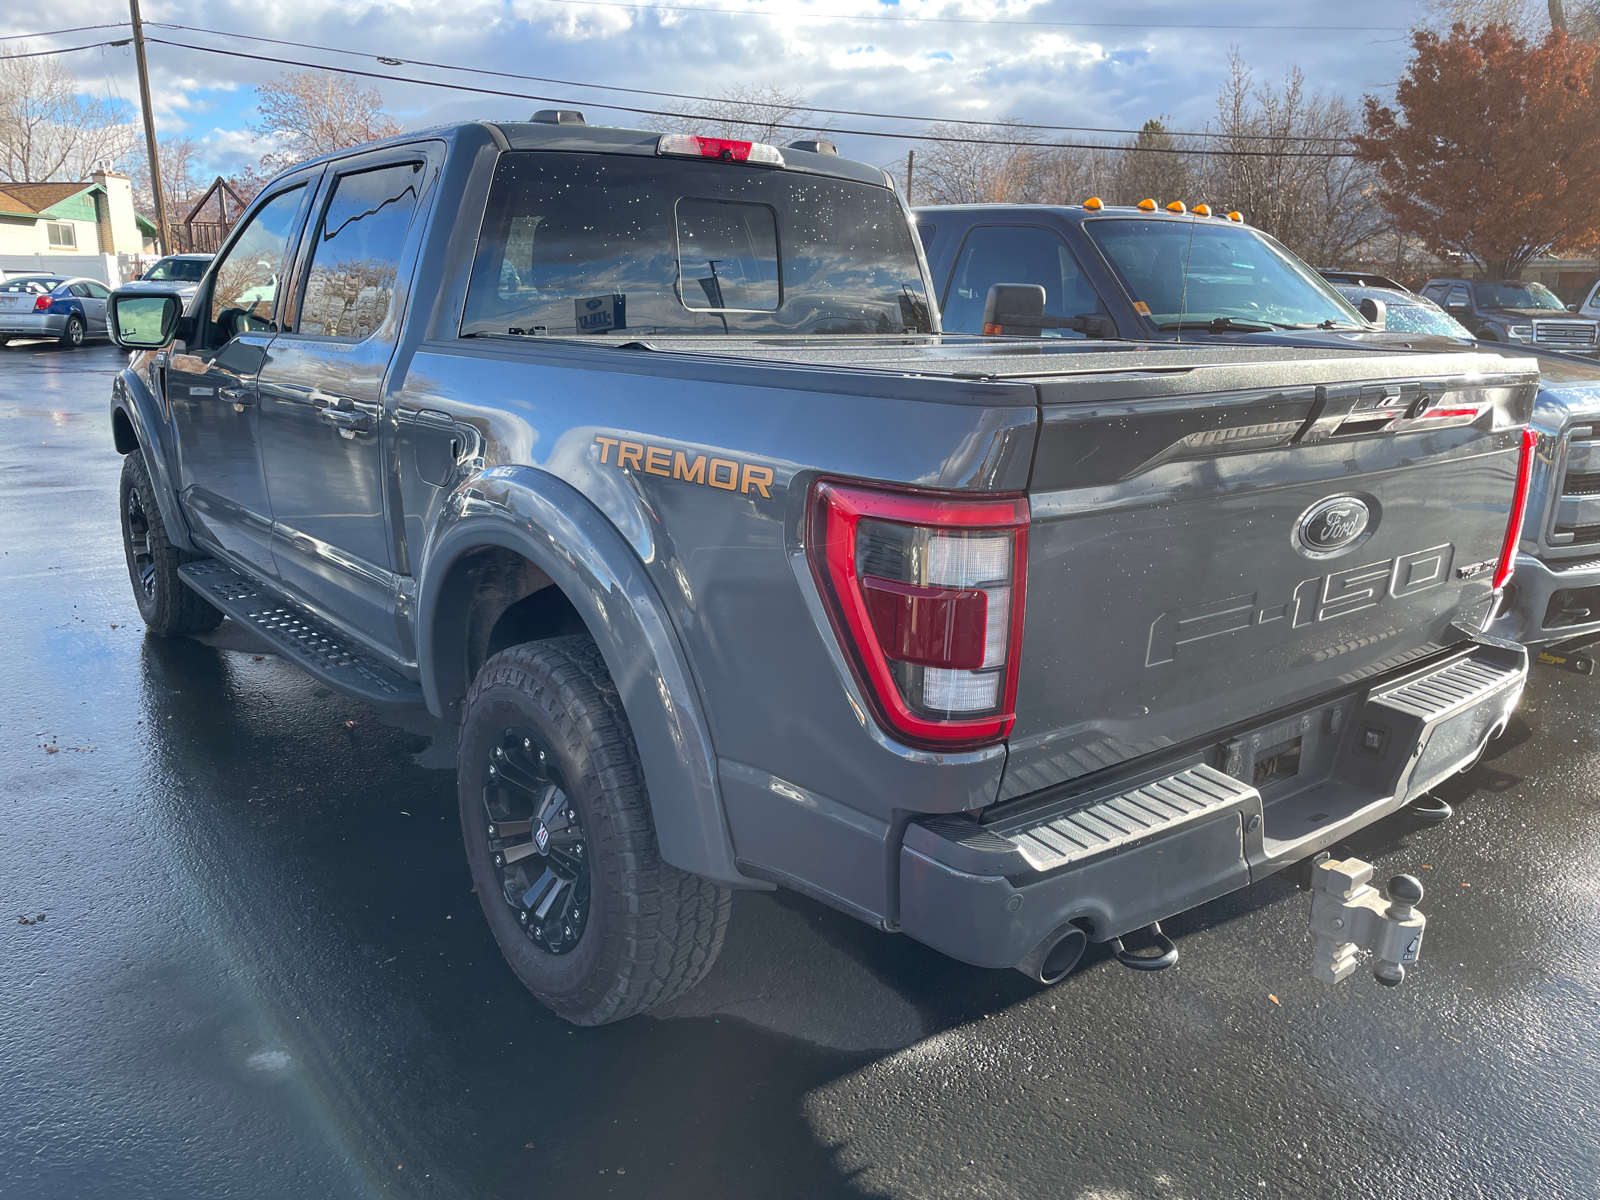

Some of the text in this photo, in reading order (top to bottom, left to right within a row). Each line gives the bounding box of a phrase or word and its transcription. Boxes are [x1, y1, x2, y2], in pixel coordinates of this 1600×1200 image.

[595, 436, 775, 499] TREMOR
[1321, 509, 1359, 541] Ford
[1145, 542, 1455, 668] F-150
